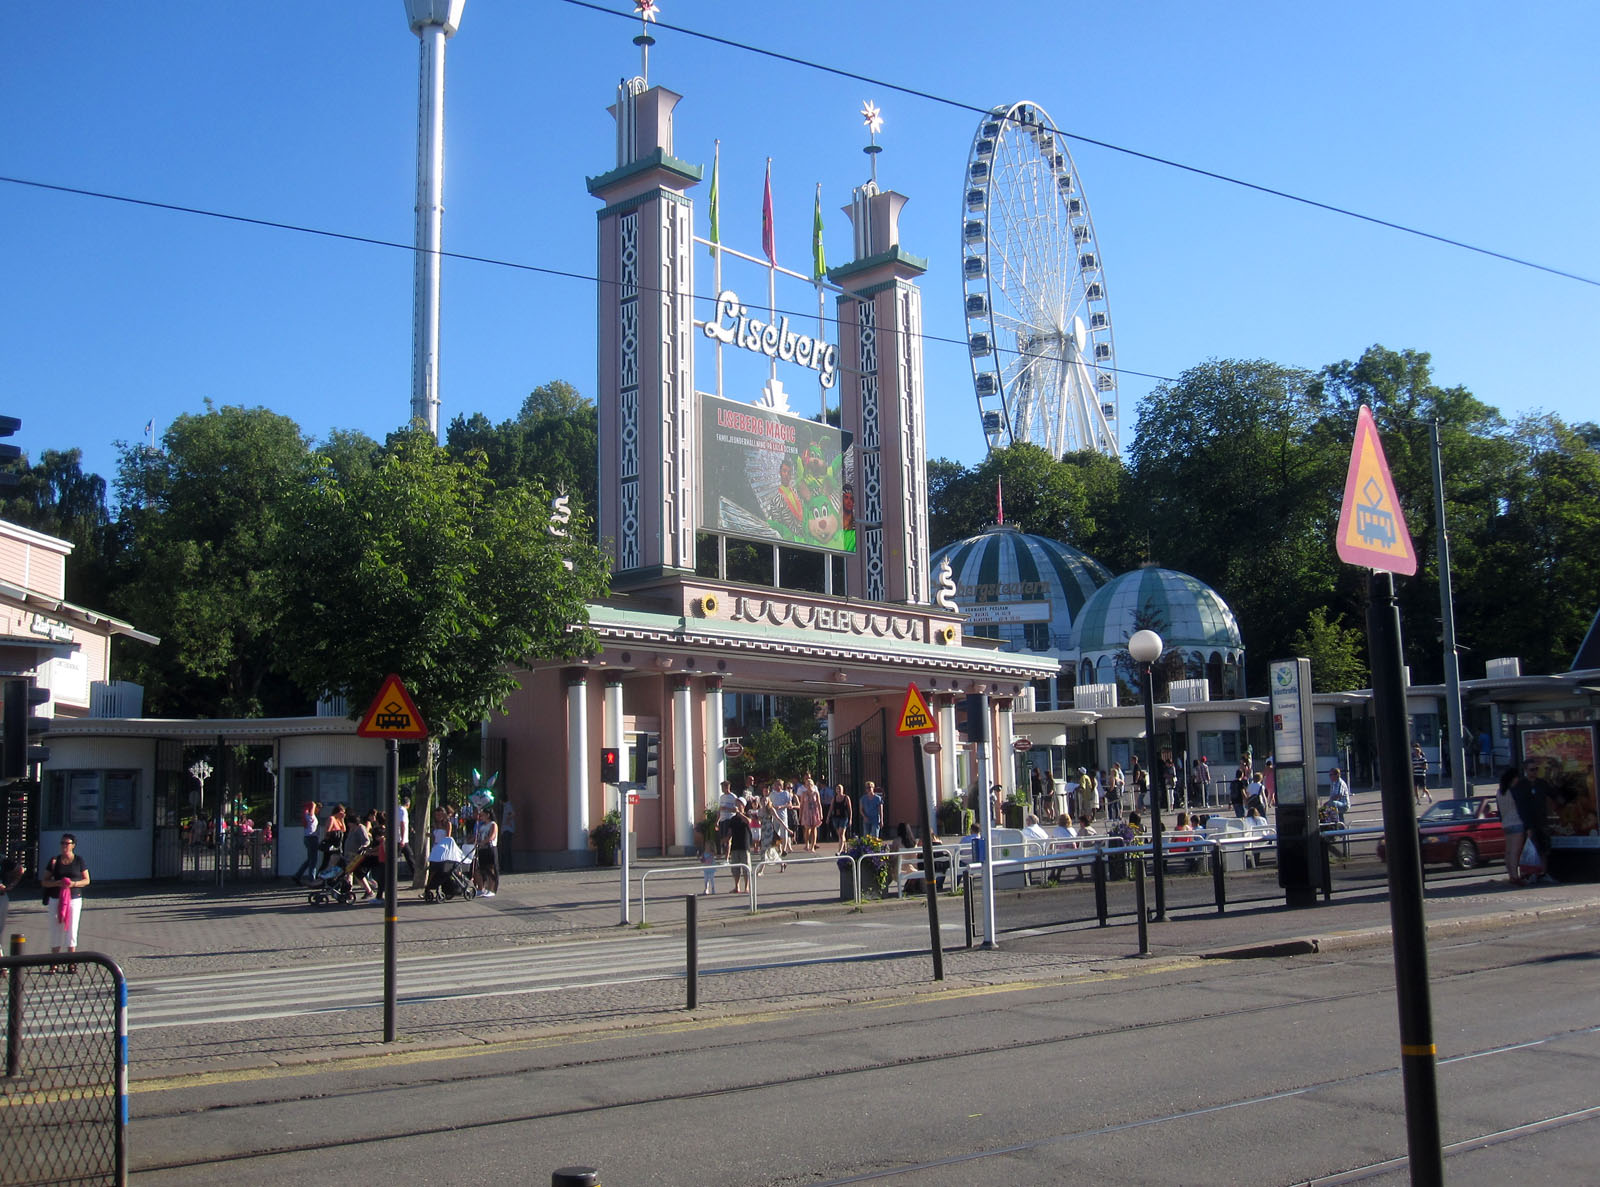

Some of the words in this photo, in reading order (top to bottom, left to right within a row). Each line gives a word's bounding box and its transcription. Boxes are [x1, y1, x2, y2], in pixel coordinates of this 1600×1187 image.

[703, 290, 840, 389] Liseberg
[717, 407, 763, 436] LISEBERG
[765, 420, 796, 443] MAGIC
